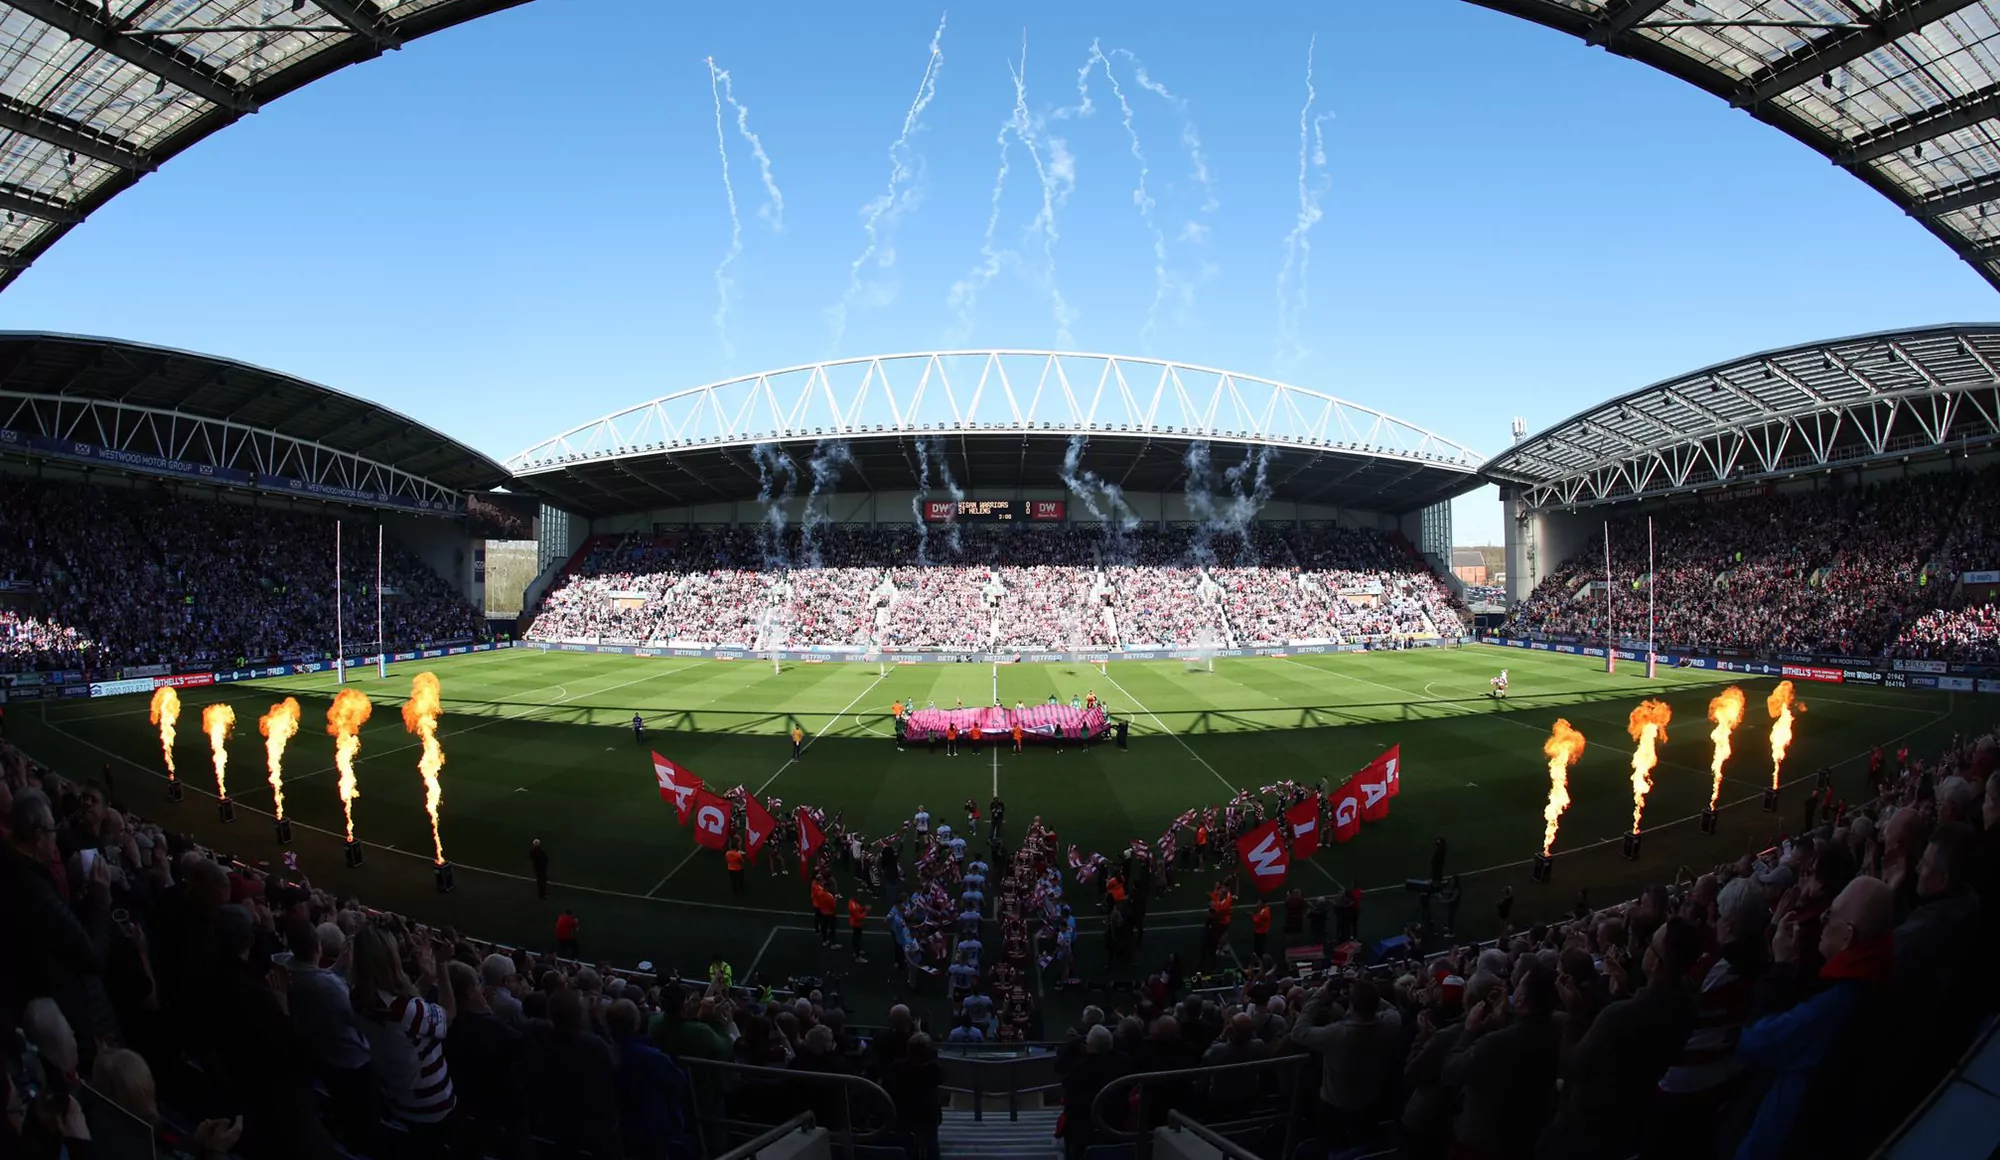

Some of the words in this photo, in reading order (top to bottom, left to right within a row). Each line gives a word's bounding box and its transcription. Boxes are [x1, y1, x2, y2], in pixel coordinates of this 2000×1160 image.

[98, 448, 141, 464] WESTWOOD
[142, 456, 167, 468] MOTOR
[168, 462, 192, 472] GROUP
[308, 484, 337, 495] WESTWOOD
[337, 487, 356, 497] MOTOR
[932, 503, 949, 513] DW
[1039, 503, 1056, 512] DW
[1507, 639, 1524, 647] BETFRED
[1531, 642, 1548, 650] BETFRED
[424, 650, 442, 658] BETFRED
[1584, 647, 1604, 656] BETFRED
[395, 653, 415, 661] BETFRED
[1781, 666, 1811, 677] BITHELL'S
[154, 676, 184, 687] BITHELL'S
[1246, 831, 1285, 876] W
[1335, 796, 1357, 828] G
[1359, 780, 1387, 809] A
